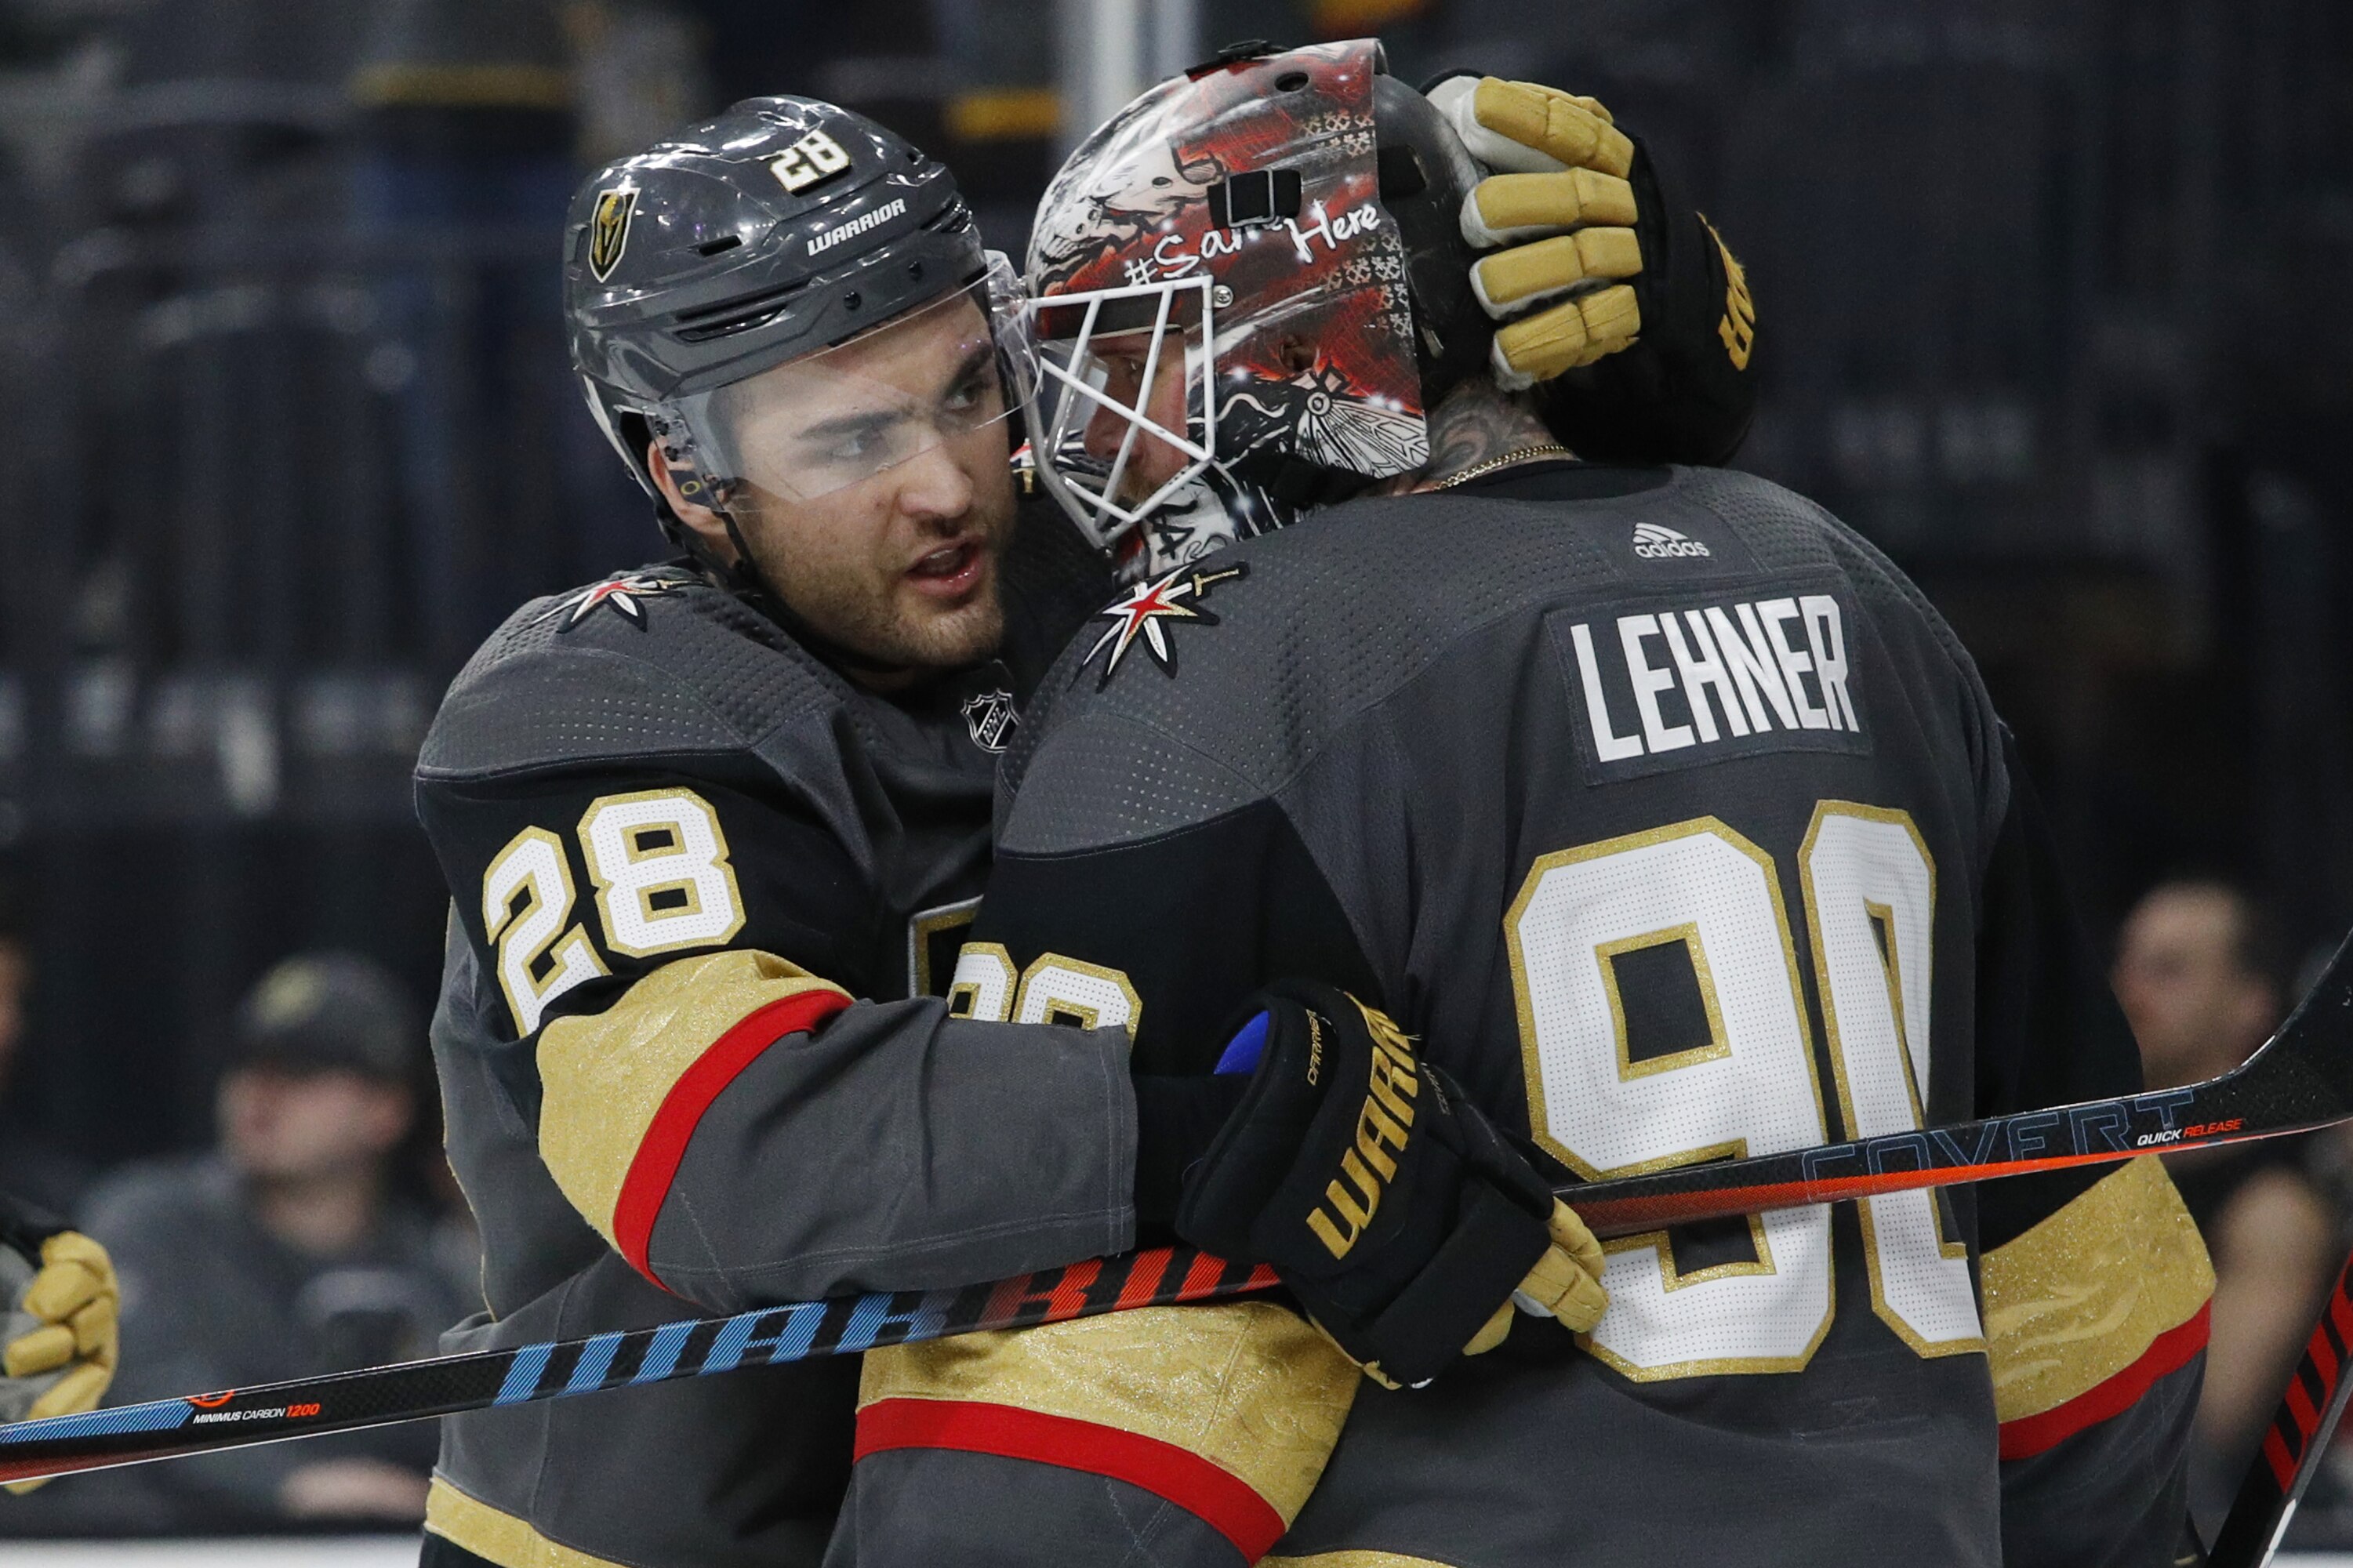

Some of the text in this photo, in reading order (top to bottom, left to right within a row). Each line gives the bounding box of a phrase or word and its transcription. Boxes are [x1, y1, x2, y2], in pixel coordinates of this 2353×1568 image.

[769, 129, 850, 193] 28
[807, 198, 906, 256] WARRIOR
[1635, 539, 1710, 558] adidas
[1570, 595, 1860, 762] LEHNER
[482, 786, 746, 1039] 28
[1504, 800, 1988, 1384] 90
[1803, 1089, 2194, 1201] COVERT
[2137, 1118, 2243, 1146] QUICK RELEASE
[193, 1403, 321, 1424] MINIMUS CARBON 1200
